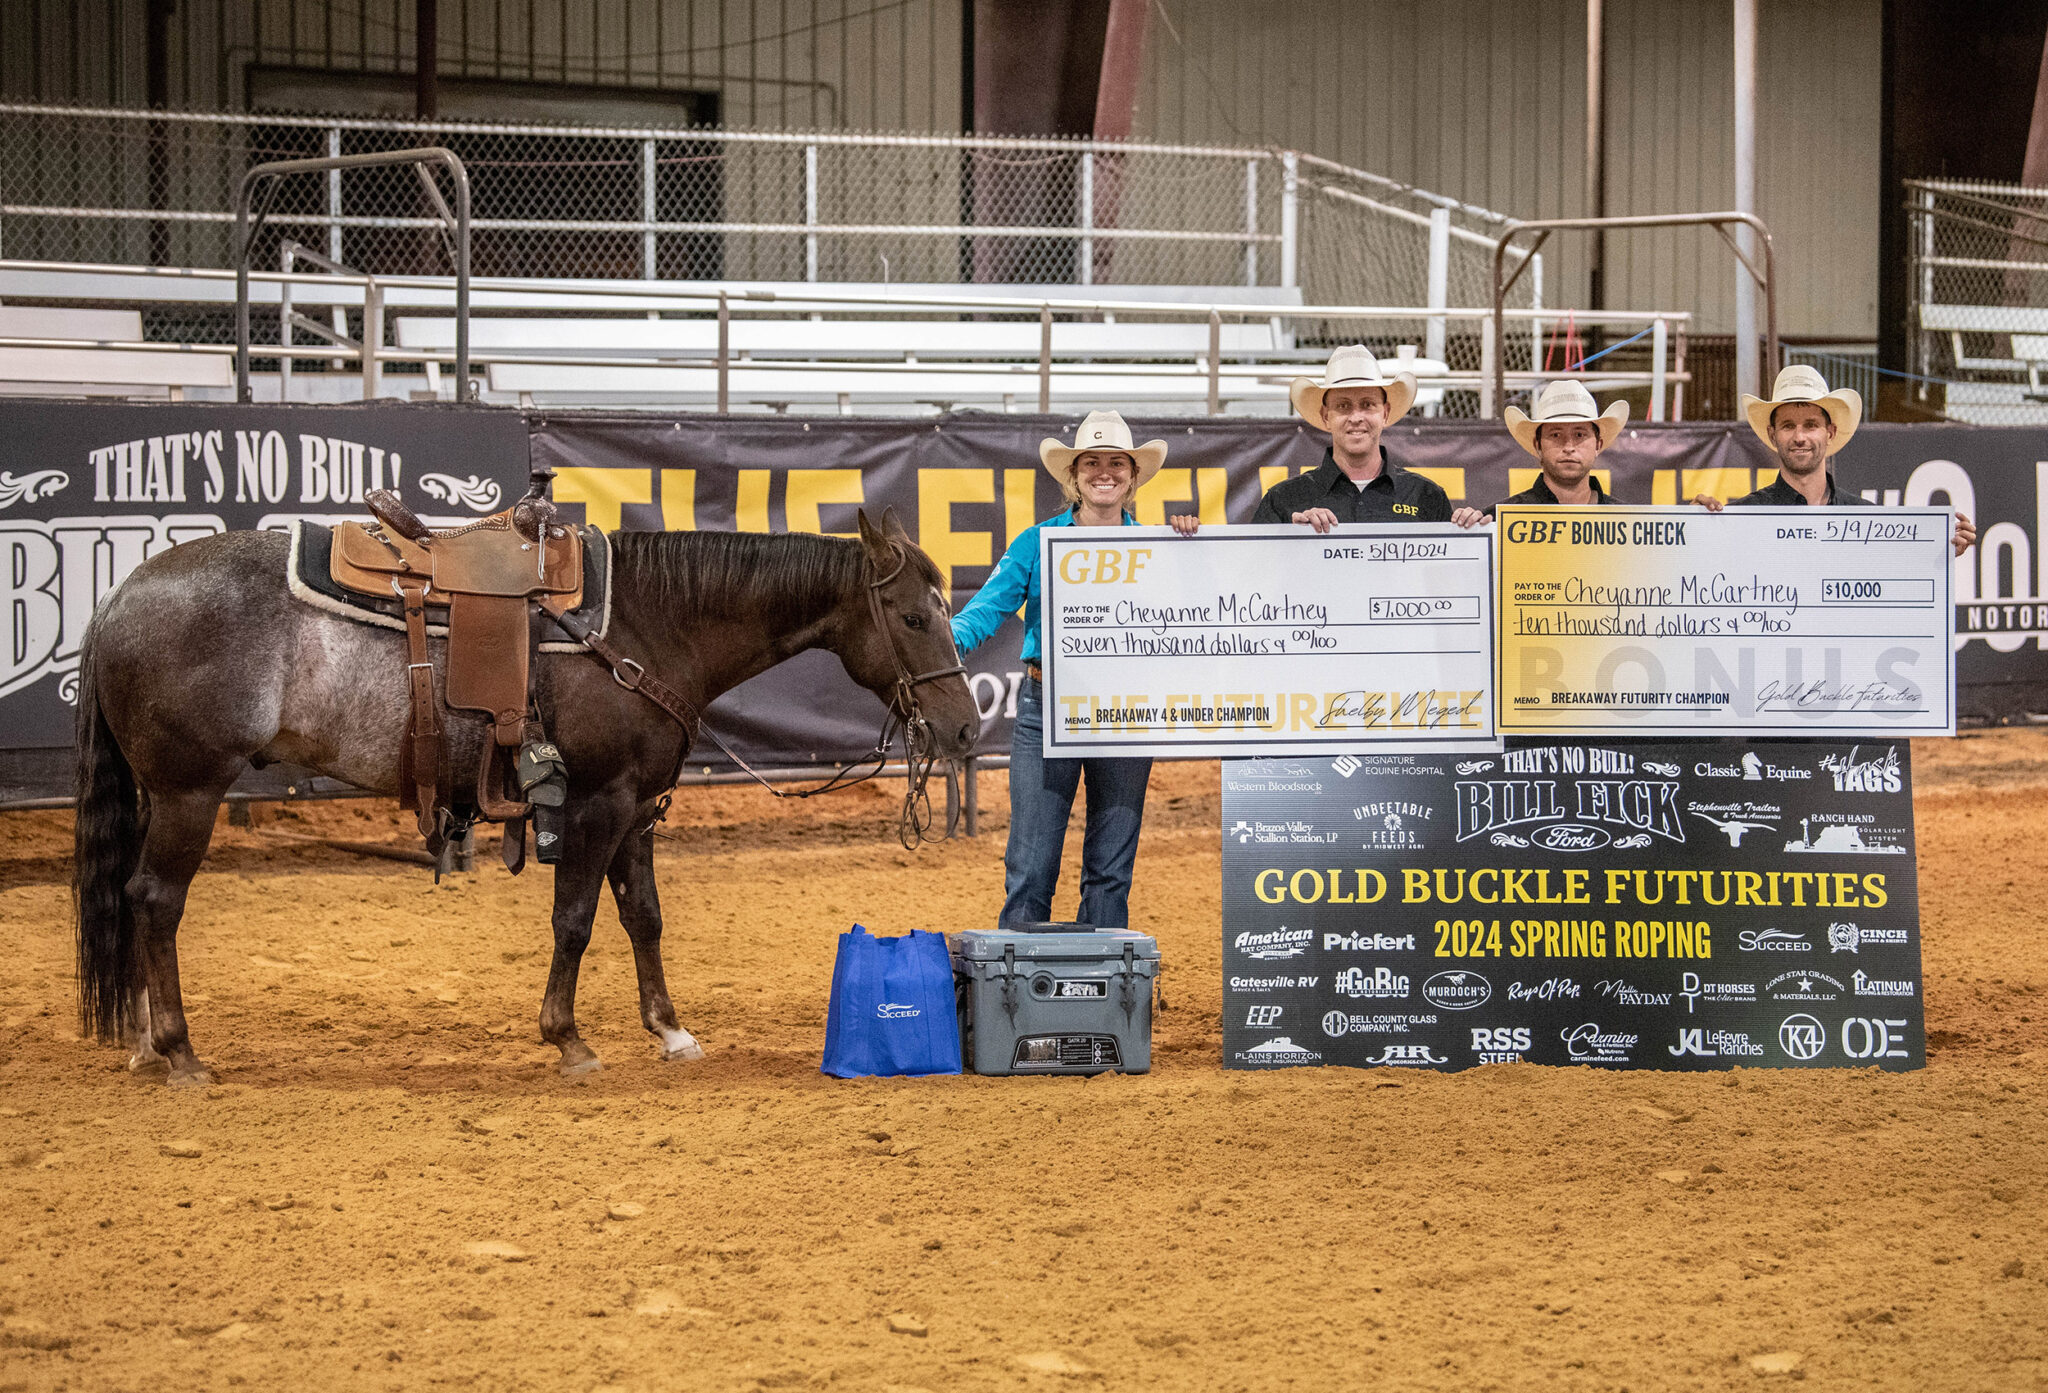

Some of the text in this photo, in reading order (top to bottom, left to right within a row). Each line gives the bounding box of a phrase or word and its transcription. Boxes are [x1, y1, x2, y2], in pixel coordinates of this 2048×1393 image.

[89, 429, 402, 504] THAT'S NO BULL!
[1392, 503, 1419, 516] GBF
[1507, 520, 1687, 546] GBF BONUS CHECK
[1777, 528, 1817, 539] DATE:
[1827, 520, 1919, 545] 5/9/2024
[1324, 548, 1364, 559] DATE:
[1370, 542, 1447, 563] 5/9/2024
[1059, 549, 1152, 585] GBF
[1514, 582, 1532, 590] PAY
[1825, 581, 1882, 600] $10,000
[1514, 593, 1556, 601] ORDER OF
[1565, 572, 1798, 621] Cheyanne McCartney
[1096, 605, 1110, 613] THE
[1115, 592, 1328, 635] Cheyanne McCartney
[1063, 616, 1104, 624] ORDER OF
[1513, 608, 1550, 635] ten
[1554, 611, 1647, 636] thousand
[1655, 613, 1721, 638] dollars
[1061, 636, 1118, 654] seven
[1121, 632, 1206, 656] thousand
[1210, 632, 1270, 655] dollars
[1519, 645, 1923, 719] BONUS
[1551, 692, 1730, 704] BREAKAWAY FUTURITY CHAMPION
[1060, 694, 1149, 735] THE
[1165, 692, 1347, 734] FUTURE
[1065, 717, 1091, 725] MEMO
[1096, 706, 1270, 723] BREAKAWAY 4 & UNDER CHAMPION
[1364, 756, 1415, 765] SIGNATURE
[1502, 747, 1635, 774] THAT'S NO BULL!
[1365, 767, 1445, 775] EQUINE HOSPITAL
[1694, 762, 1812, 782] Classic Equine
[1227, 781, 1322, 791] Western Bloodstock
[1353, 801, 1433, 820] UNBEETABLE
[1455, 780, 1685, 843] BILL FICK
[1687, 801, 1781, 812] Stephenville Trailers
[1811, 814, 1875, 823] RANCH HAND
[1255, 821, 1314, 835] Brazos Valley
[1255, 832, 1338, 844] Stallion Station, LP
[1372, 831, 1415, 843] FEEDS
[1545, 826, 1596, 848] Ford
[1254, 868, 1888, 908] GOLD BUCKLE FUTURITIES
[1235, 928, 1313, 948] American
[1323, 930, 1416, 951] Priefert
[1434, 919, 1712, 959] 2024 SPRING ROPING
[1860, 929, 1908, 939] CINCH
[1241, 945, 1255, 953] HAT
[1230, 975, 1319, 987] Gatesville RV
[1703, 983, 1755, 994] DT HORSES
[1765, 970, 1845, 992] LONE STAR GRADING
[1429, 986, 1486, 997] MURDOCH'S
[1619, 993, 1673, 1005] PAYDAY
[1780, 993, 1822, 1001] MATERIALS,
[1823, 993, 1836, 1001] LLC
[1245, 1005, 1283, 1026] EEP
[1350, 1015, 1437, 1023] BELL COUNTY GLASS
[1350, 1024, 1410, 1033] COMPANY, INC.
[1471, 1027, 1532, 1051] RSS
[1560, 1023, 1638, 1056] Carmine
[1706, 1029, 1749, 1045] LeFevre
[1235, 1052, 1322, 1060] PLAINS HORIZON
[1719, 1040, 1764, 1056] Ranches
